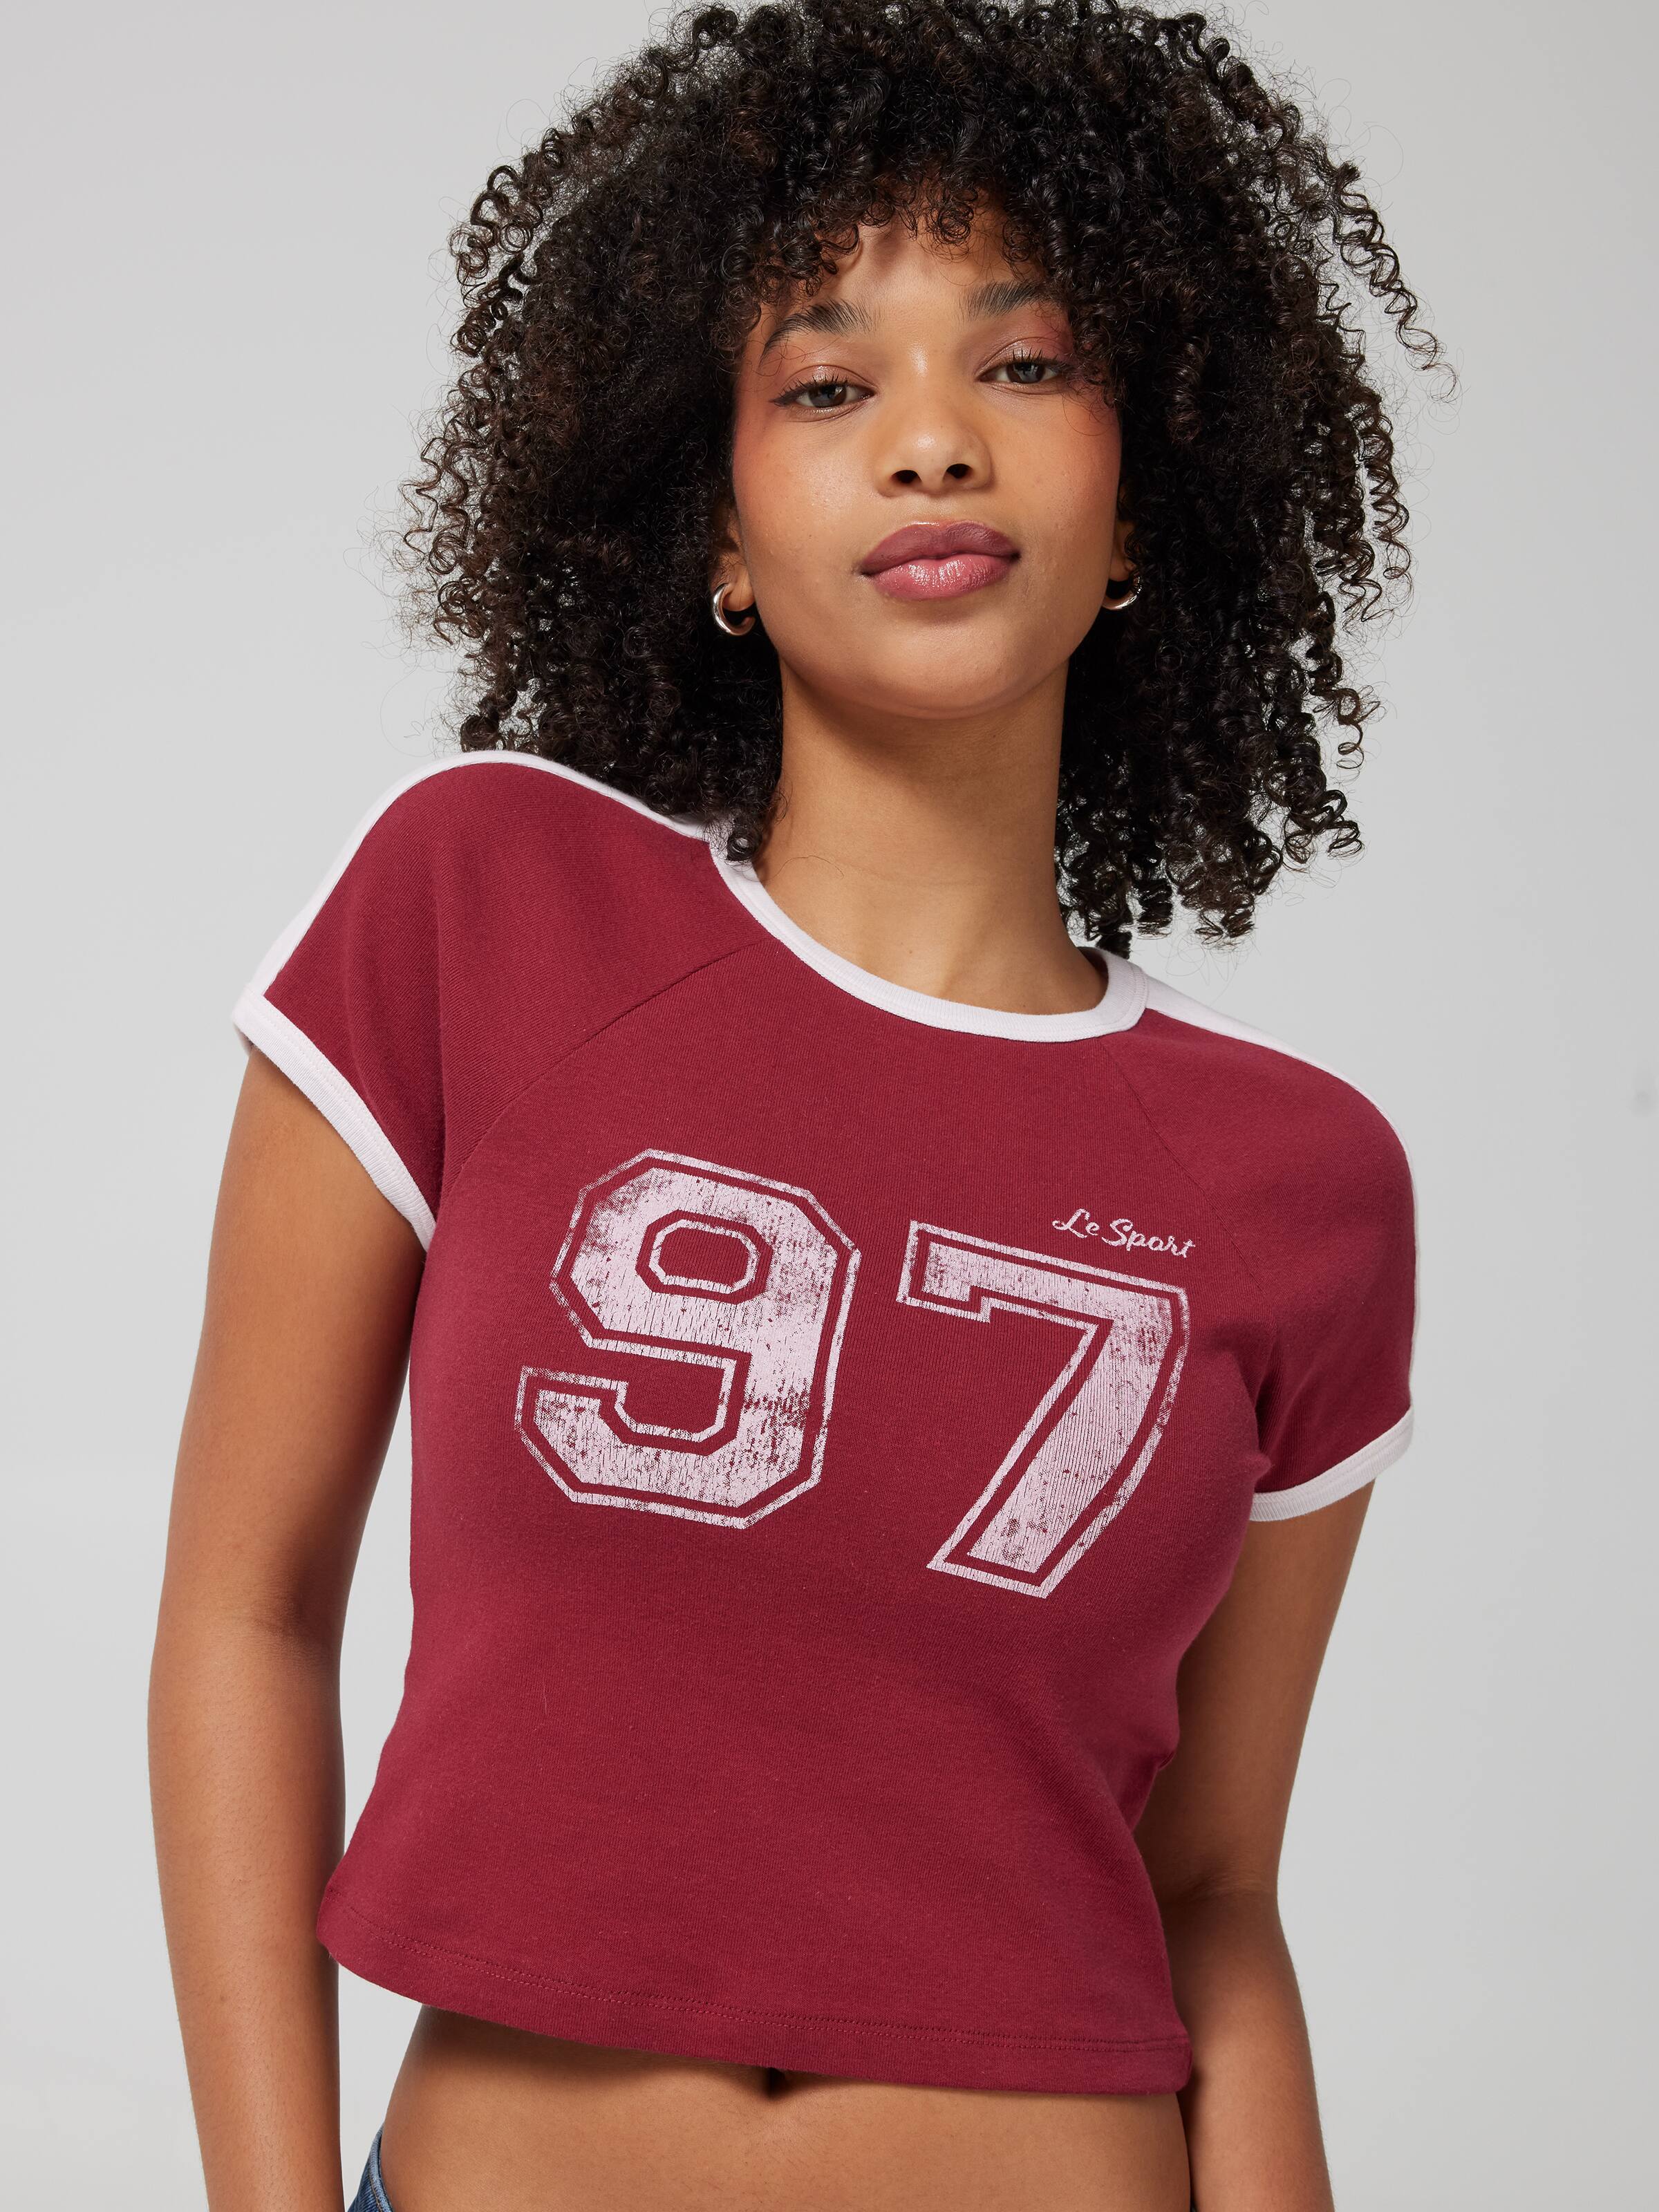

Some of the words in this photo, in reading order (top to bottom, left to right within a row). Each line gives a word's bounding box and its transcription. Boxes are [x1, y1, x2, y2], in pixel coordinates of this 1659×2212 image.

[1052, 1208, 1100, 1239] Le
[1101, 1218, 1196, 1258] Sport
[514, 1148, 1190, 1599] 97
